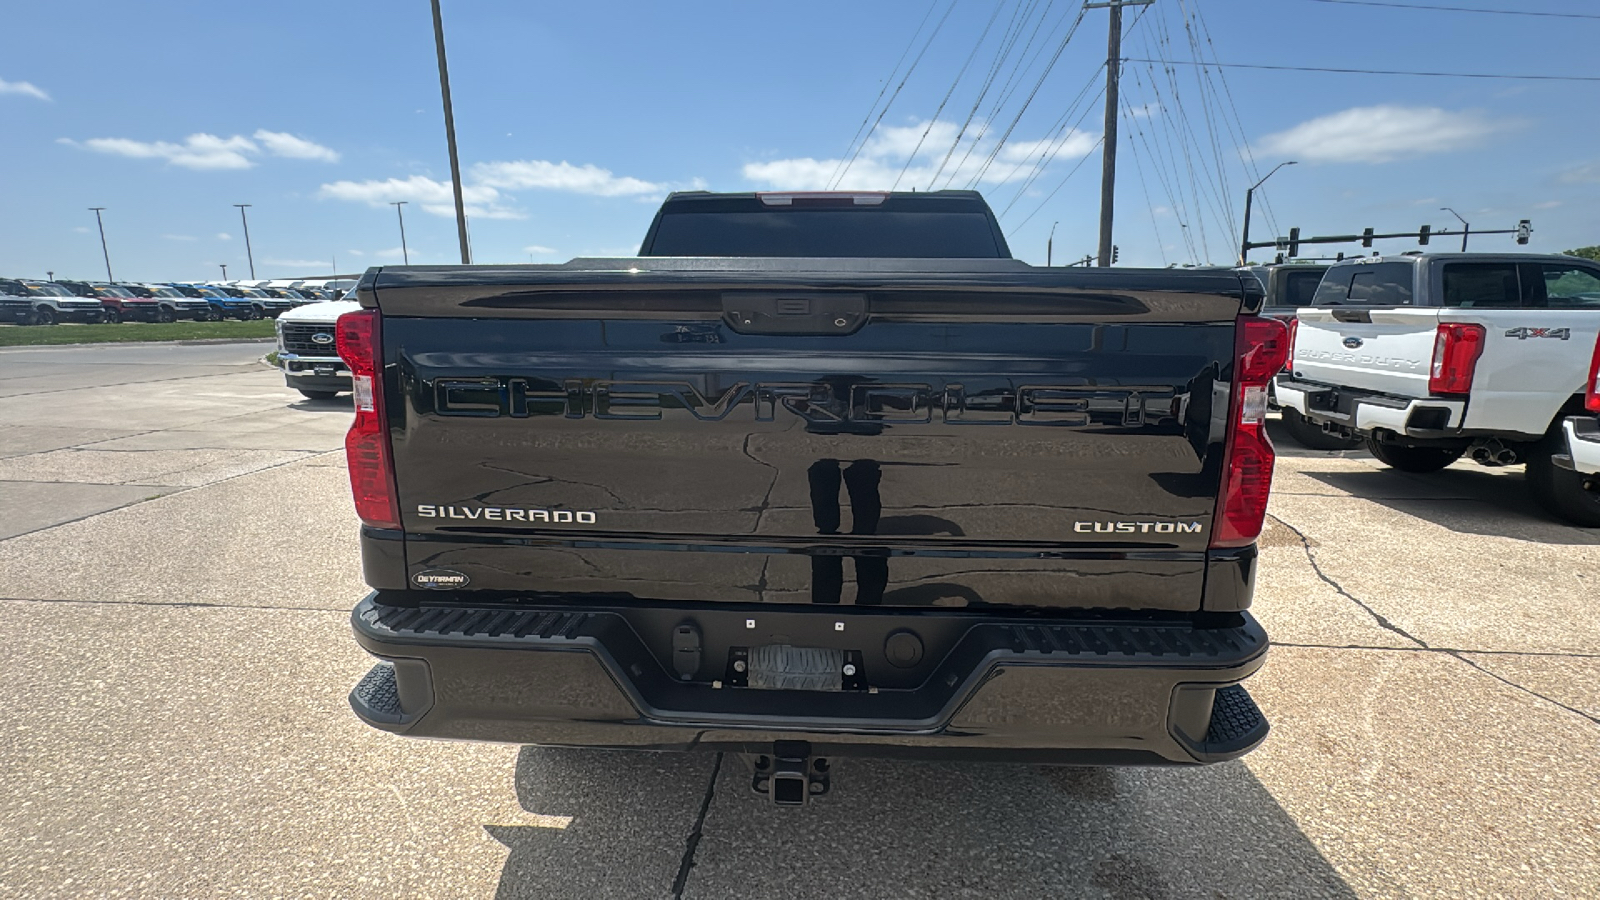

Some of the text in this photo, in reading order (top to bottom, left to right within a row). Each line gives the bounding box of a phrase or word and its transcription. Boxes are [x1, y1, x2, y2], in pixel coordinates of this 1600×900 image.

[1299, 349, 1421, 369] SUPER DUTY
[433, 376, 1176, 426] CHEVROLET
[417, 504, 596, 524] SILVERADO
[1073, 521, 1203, 533] CUSTOM
